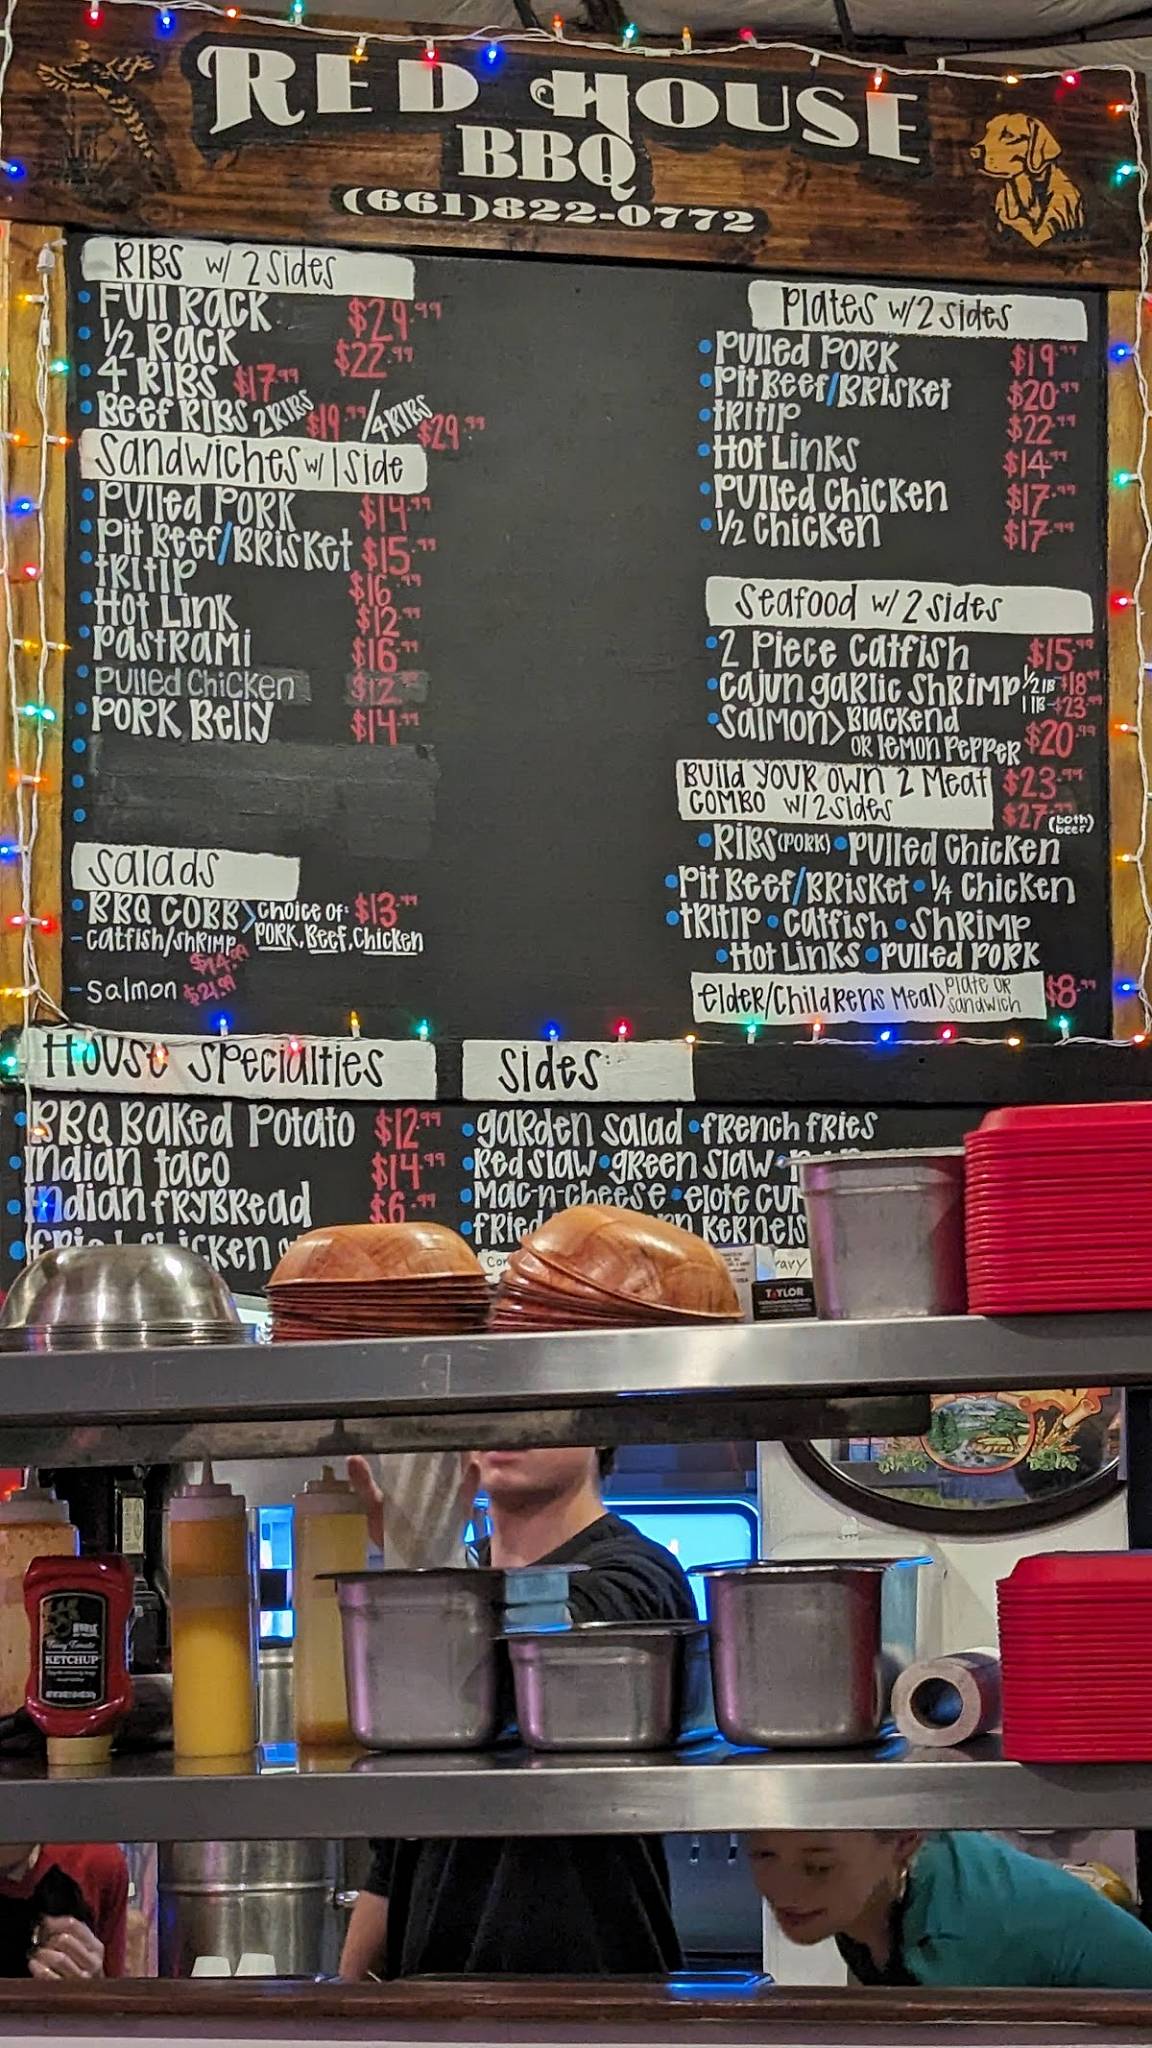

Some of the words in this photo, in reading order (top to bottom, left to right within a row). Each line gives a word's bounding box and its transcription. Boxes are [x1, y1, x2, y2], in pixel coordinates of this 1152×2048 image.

[197, 45, 479, 135] RED
[530, 71, 920, 164] HOUSE
[456, 124, 637, 202] BBQ
[342, 187, 756, 234] (661)822-0772
[115, 241, 183, 280] RIBS
[348, 297, 443, 342] $29.99
[103, 318, 136, 360] 1/2
[335, 341, 415, 380] $22.99
[1010, 343, 1077, 377] $19.99
[97, 357, 128, 395] 4
[138, 358, 219, 399] RIBS
[233, 363, 300, 402] $17.99
[1006, 379, 1079, 412] $20.99
[180, 398, 248, 434] RIBS
[416, 411, 487, 451] $29.99
[1006, 414, 1077, 446] $22.99
[1003, 449, 1068, 480] $14.99
[359, 493, 432, 533] $14.99
[1005, 483, 1077, 519] $17.99
[716, 510, 746, 547] 1/2
[1003, 518, 1075, 554] $17.99
[362, 536, 437, 576] $15.99
[349, 570, 422, 606] $16.99
[93, 588, 149, 628] Hot
[355, 606, 421, 638] $12.99
[351, 637, 418, 673] $16.99
[718, 628, 740, 669] 2
[1027, 637, 1095, 672] $15.99
[350, 708, 420, 746] $14.99
[1024, 719, 1096, 759] $20.99
[898, 768, 914, 798] 2
[1002, 765, 1083, 800] $23.99
[931, 870, 953, 905] 1/4
[87, 891, 152, 926] BBQ
[1046, 974, 1096, 1009] $8.99
[30, 1100, 110, 1146] BBQ
[374, 1107, 441, 1150] $12.99
[24, 1145, 141, 1187] Indian
[371, 1151, 446, 1191] $14.99
[774, 1257, 808, 1276] ravy
[45, 1655, 99, 1665] KETCHUP
